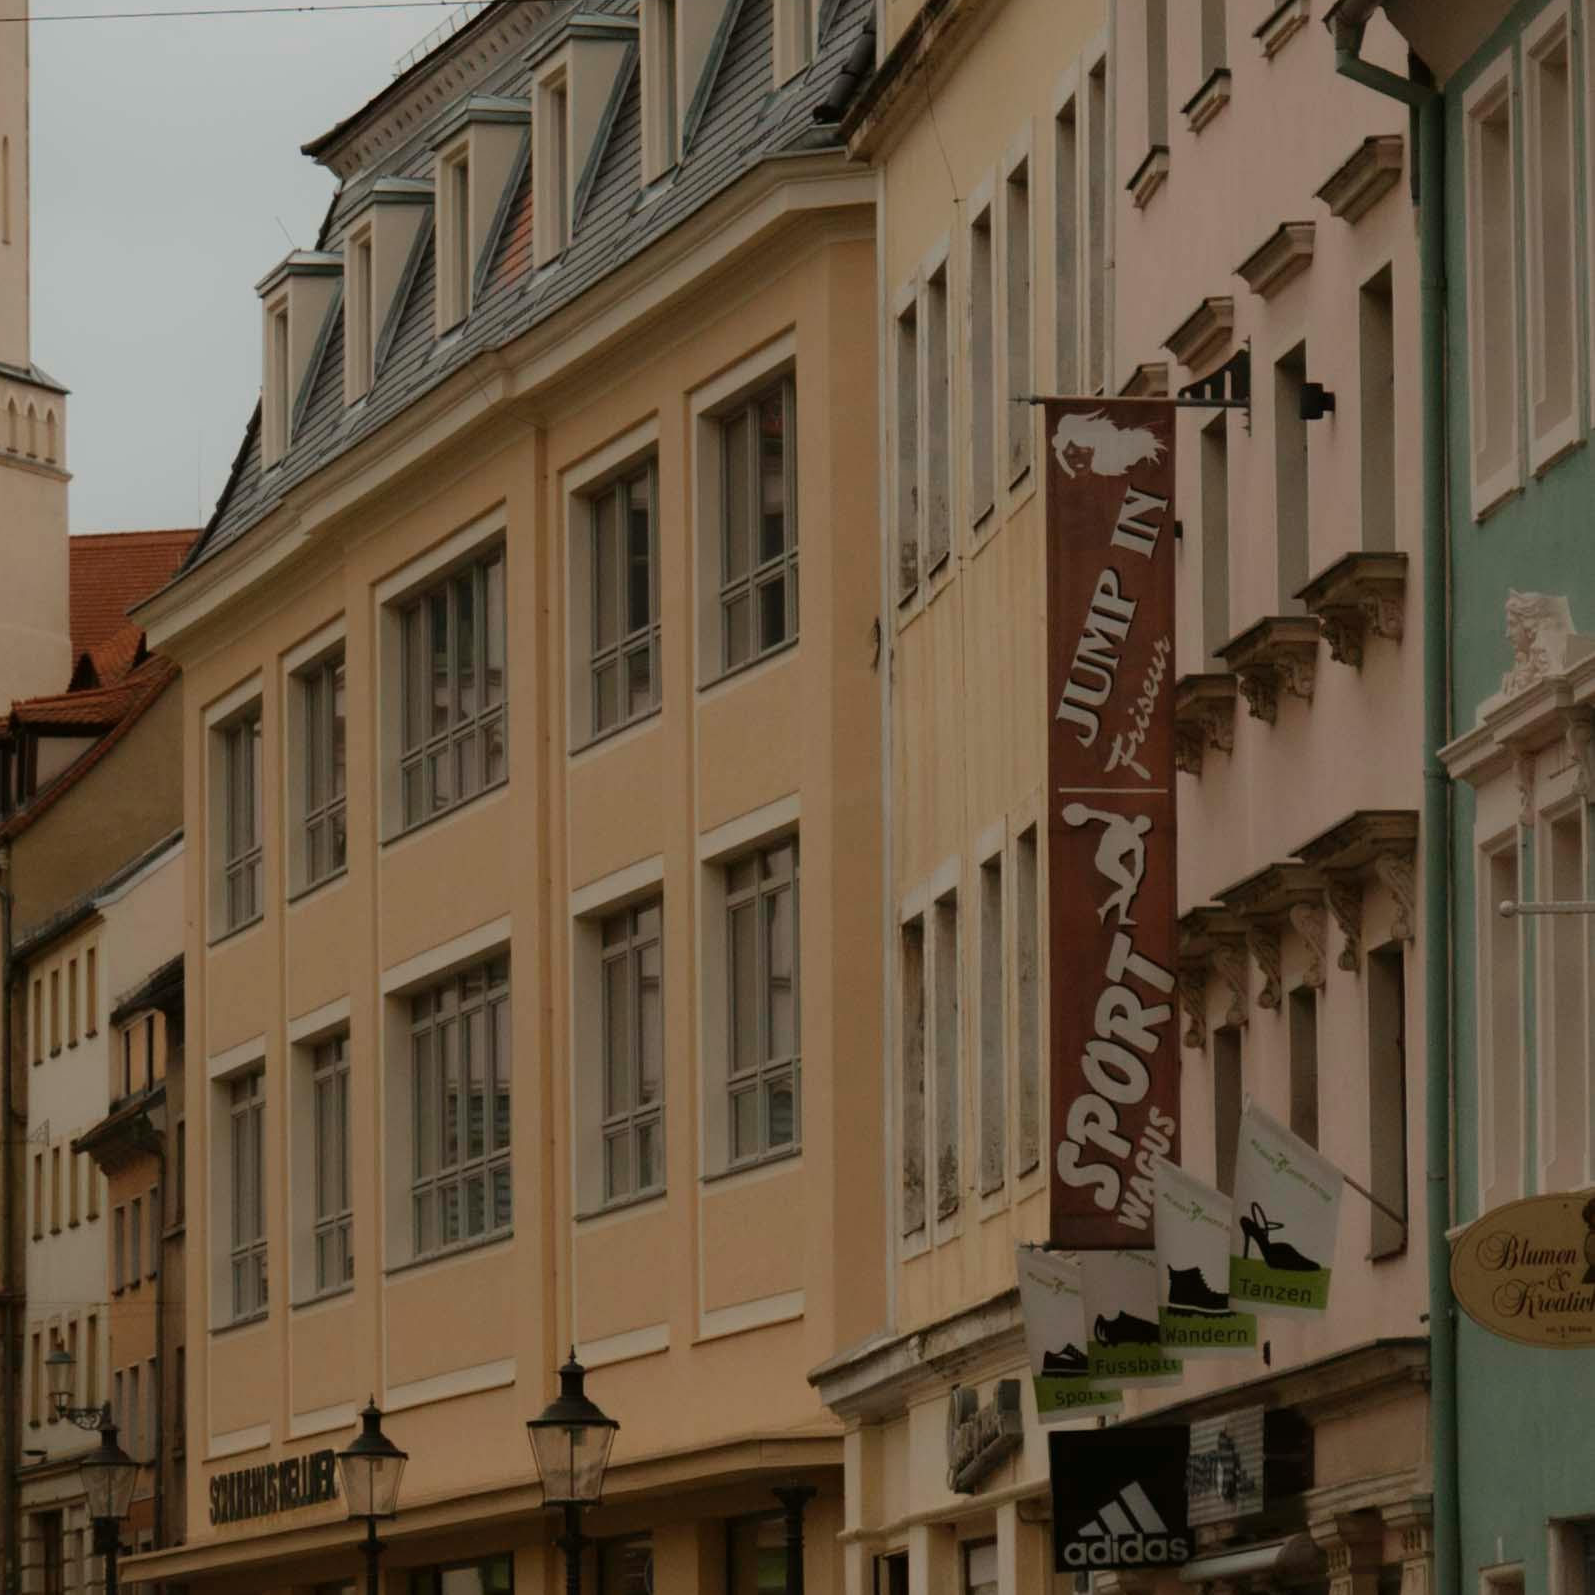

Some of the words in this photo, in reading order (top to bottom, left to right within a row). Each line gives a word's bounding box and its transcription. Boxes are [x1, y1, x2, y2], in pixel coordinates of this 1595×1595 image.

[1055, 567, 1140, 748] JUMP
[1110, 486, 1169, 560] IN
[1103, 635, 1175, 780] Friseur
[1057, 931, 1176, 1211] SPORT
[1117, 1105, 1176, 1231] WAGUS
[1238, 1277, 1313, 1304] Tanzen
[1476, 1229, 1577, 1271] Blumen
[1163, 1324, 1248, 1344] Wandern
[1063, 1532, 1191, 1567] adidas
